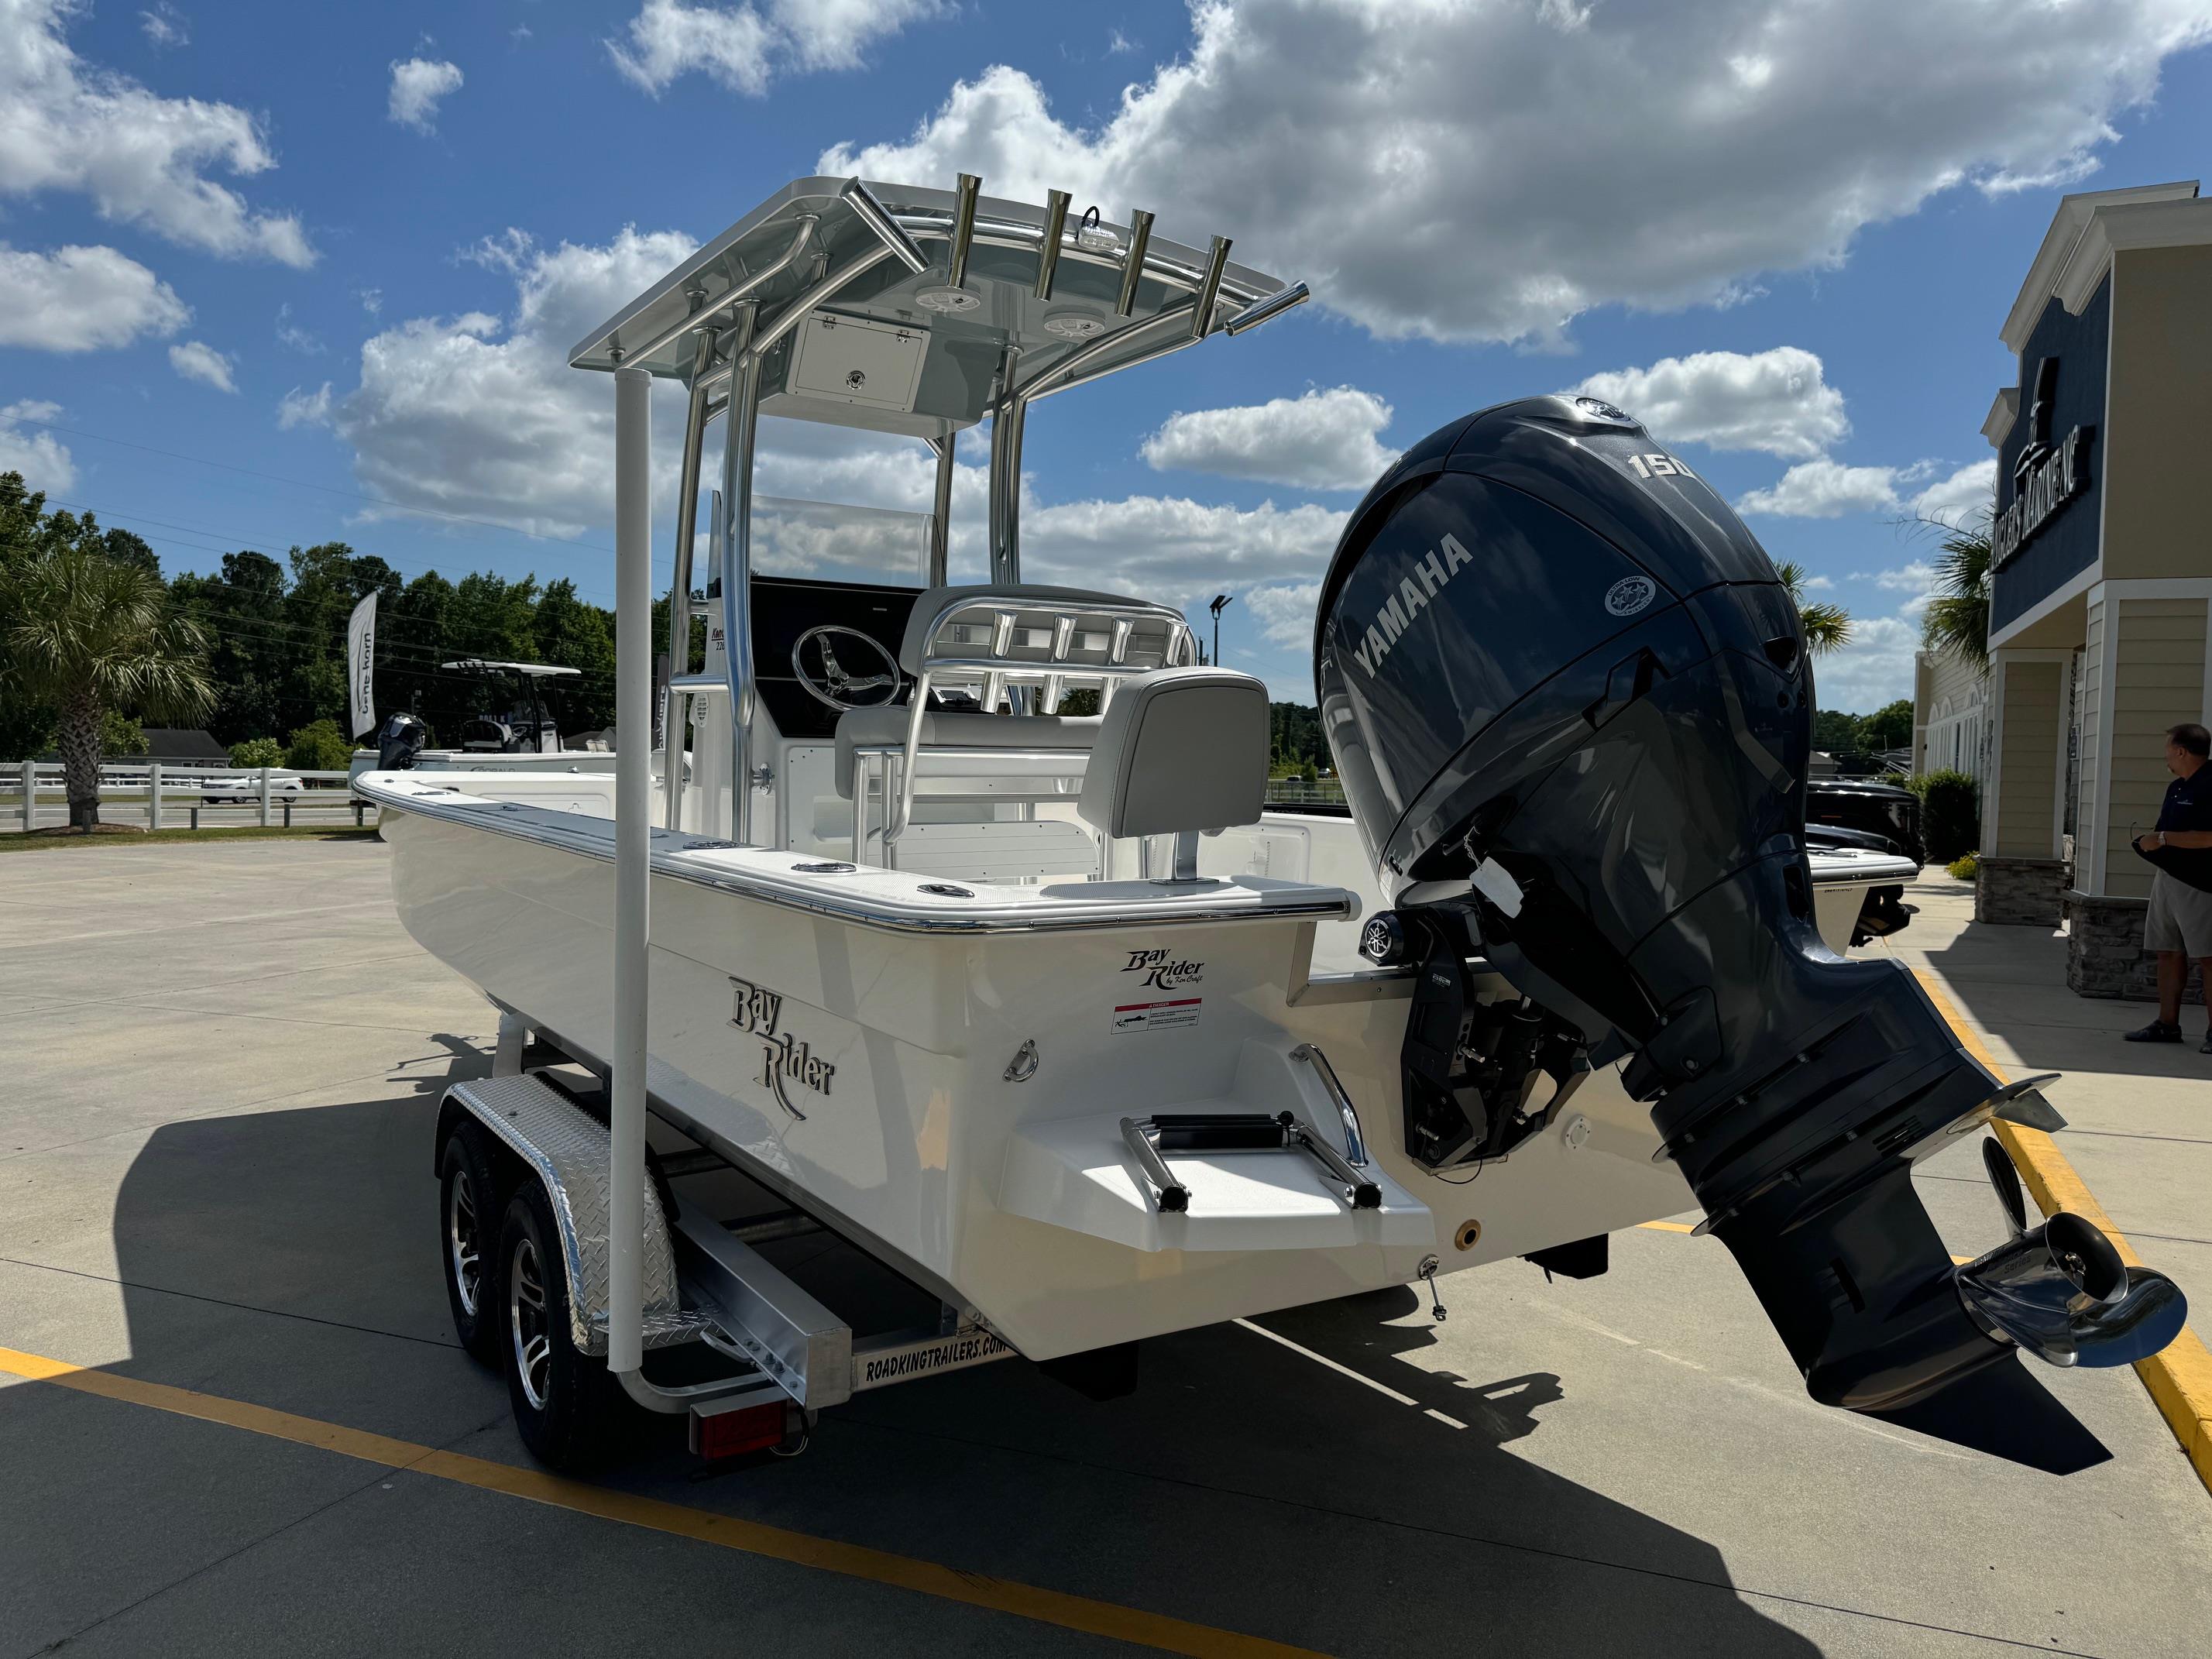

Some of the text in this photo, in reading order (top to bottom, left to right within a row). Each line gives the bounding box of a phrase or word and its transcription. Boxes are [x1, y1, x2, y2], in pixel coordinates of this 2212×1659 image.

[1354, 533, 1473, 678] YAMAHA
[1119, 949, 1172, 972] Bay
[1139, 960, 1205, 991] Rider
[1166, 977, 1173, 985] by
[726, 976, 782, 1036] Bay
[752, 1032, 836, 1121] Rider
[866, 1338, 1007, 1382] ROADKINGTRAILERS.COM
